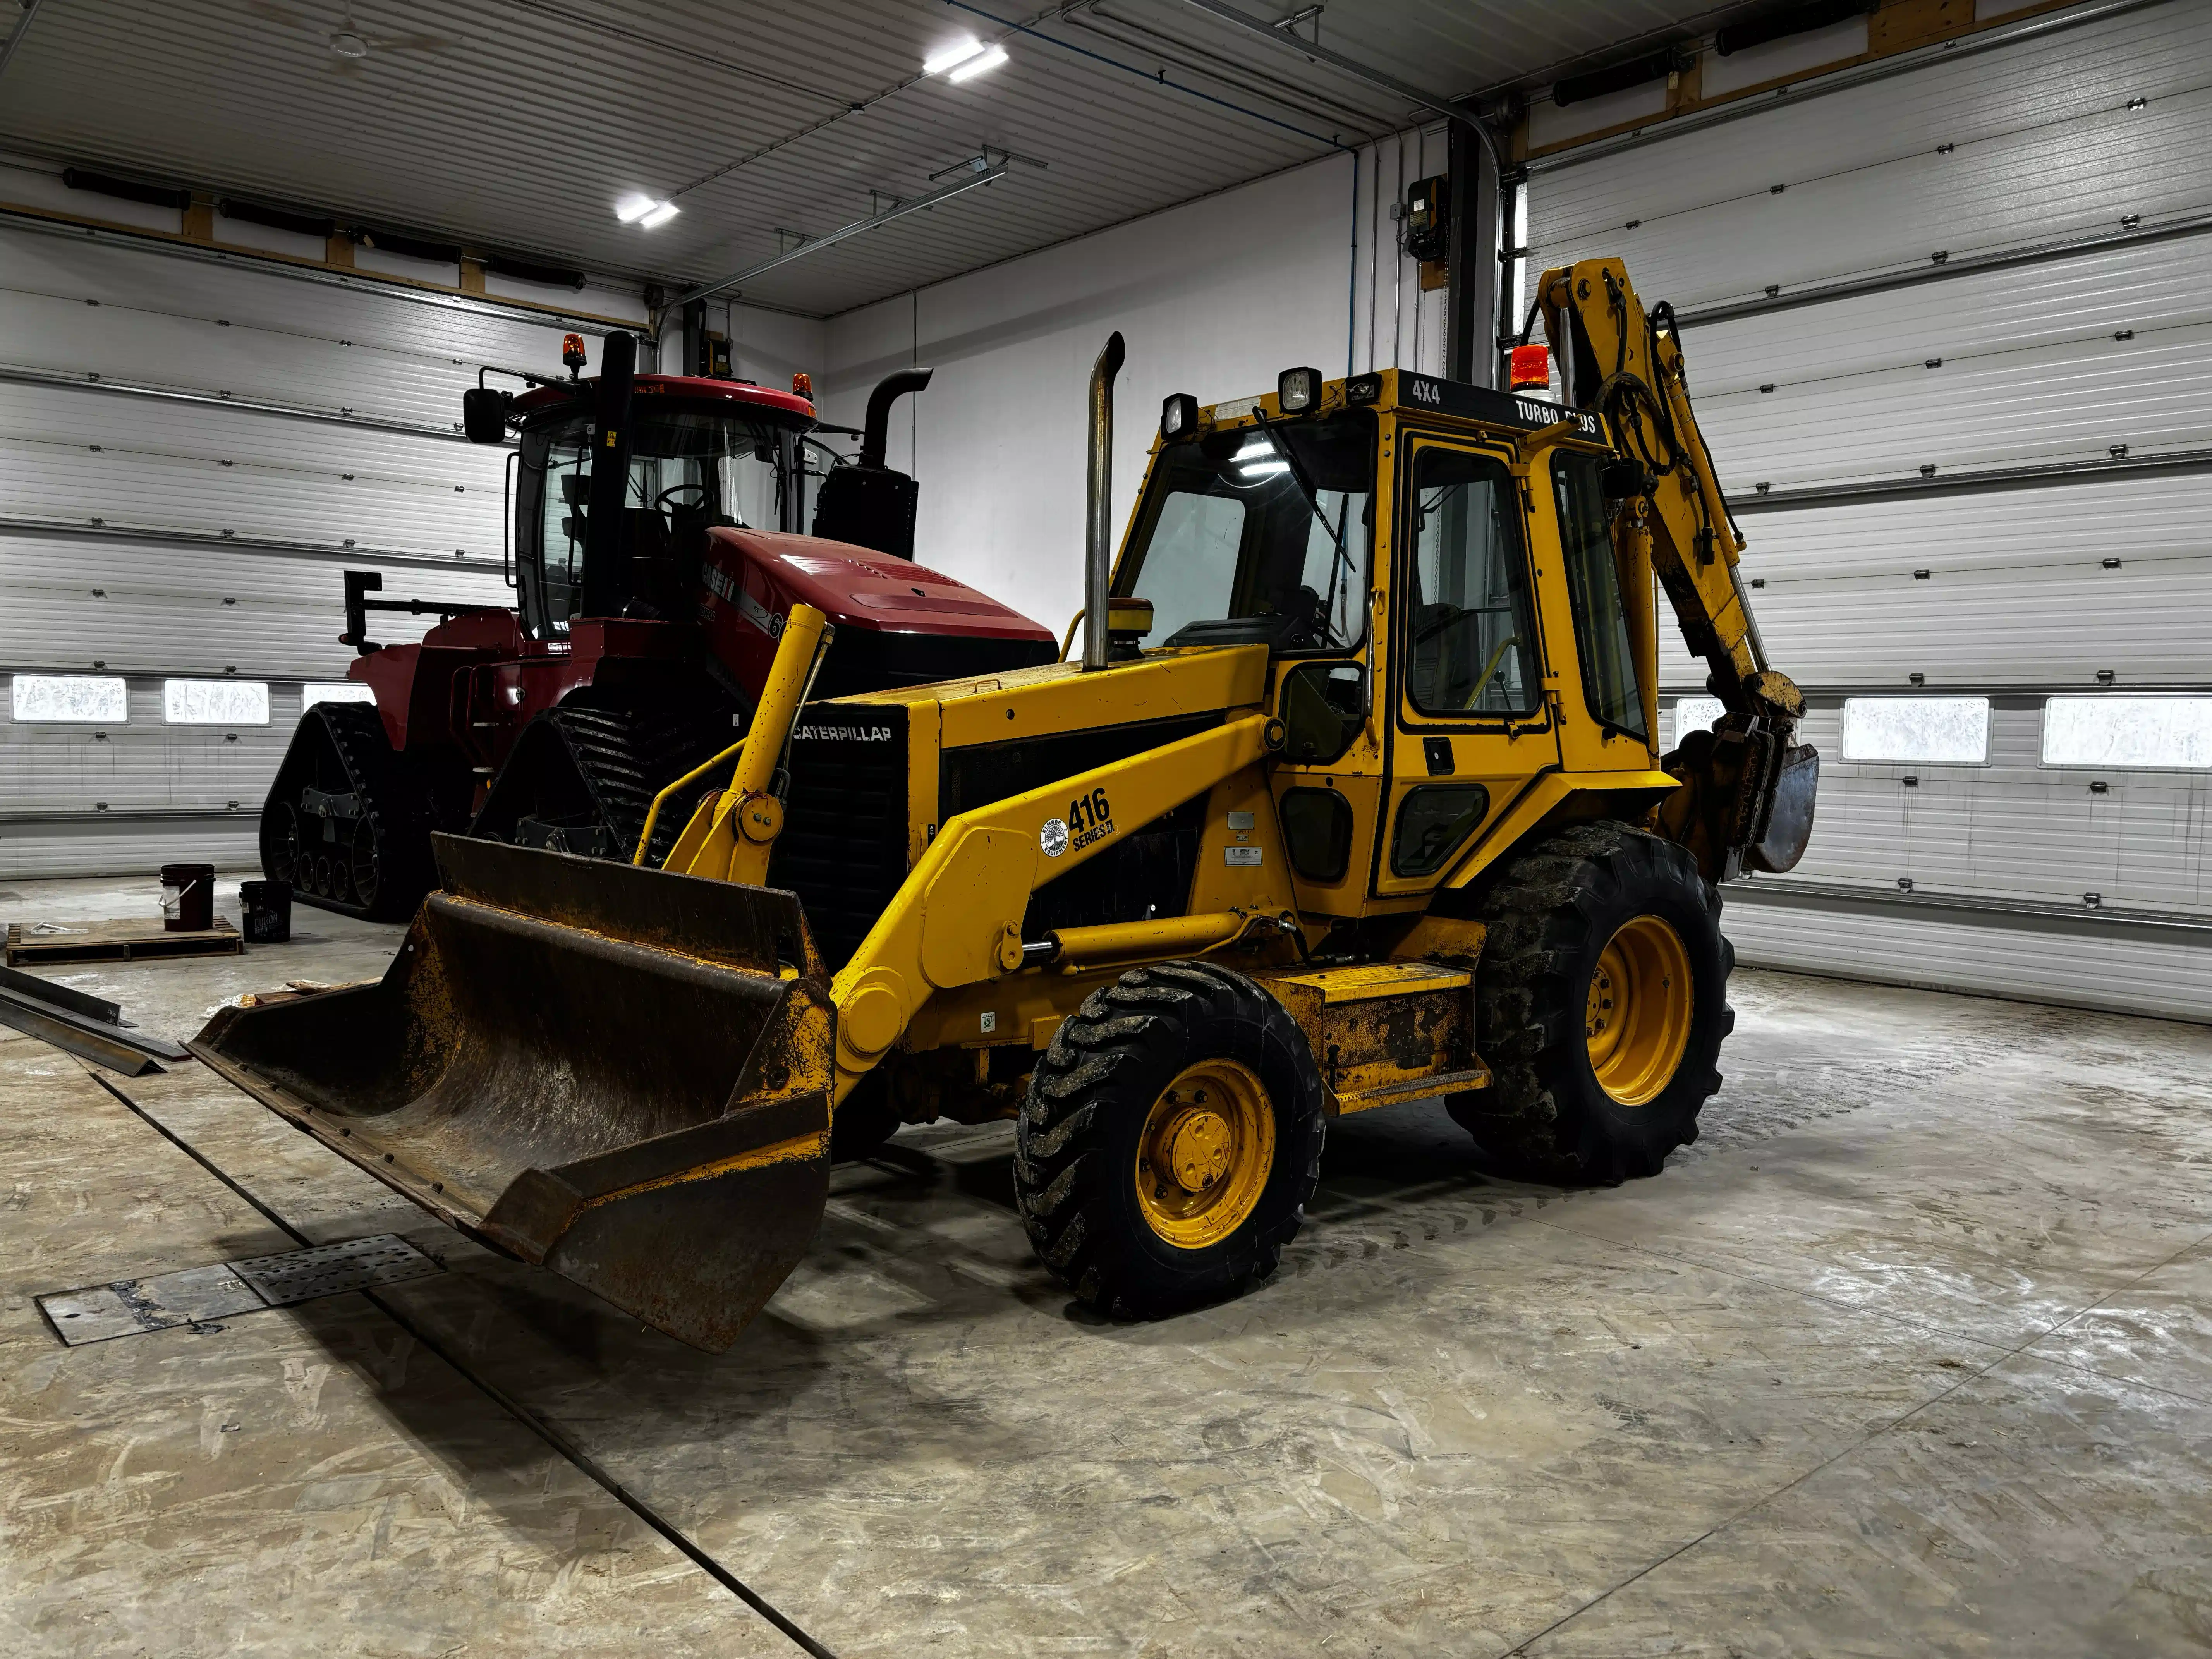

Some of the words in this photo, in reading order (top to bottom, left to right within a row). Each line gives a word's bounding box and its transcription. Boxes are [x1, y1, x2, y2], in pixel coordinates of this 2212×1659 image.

[1413, 379, 1441, 405] 4X4
[1516, 400, 1559, 425] TURBO
[702, 560, 725, 595] CASE
[793, 725, 892, 742] CATERPILLAR
[1069, 787, 1110, 833] 416
[1042, 819, 1061, 833] ELMROC
[1073, 824, 1106, 852] SERIES
[1105, 819, 1115, 835] II
[1044, 836, 1068, 856] EQUIPMENT
[254, 912, 278, 928] DURON
